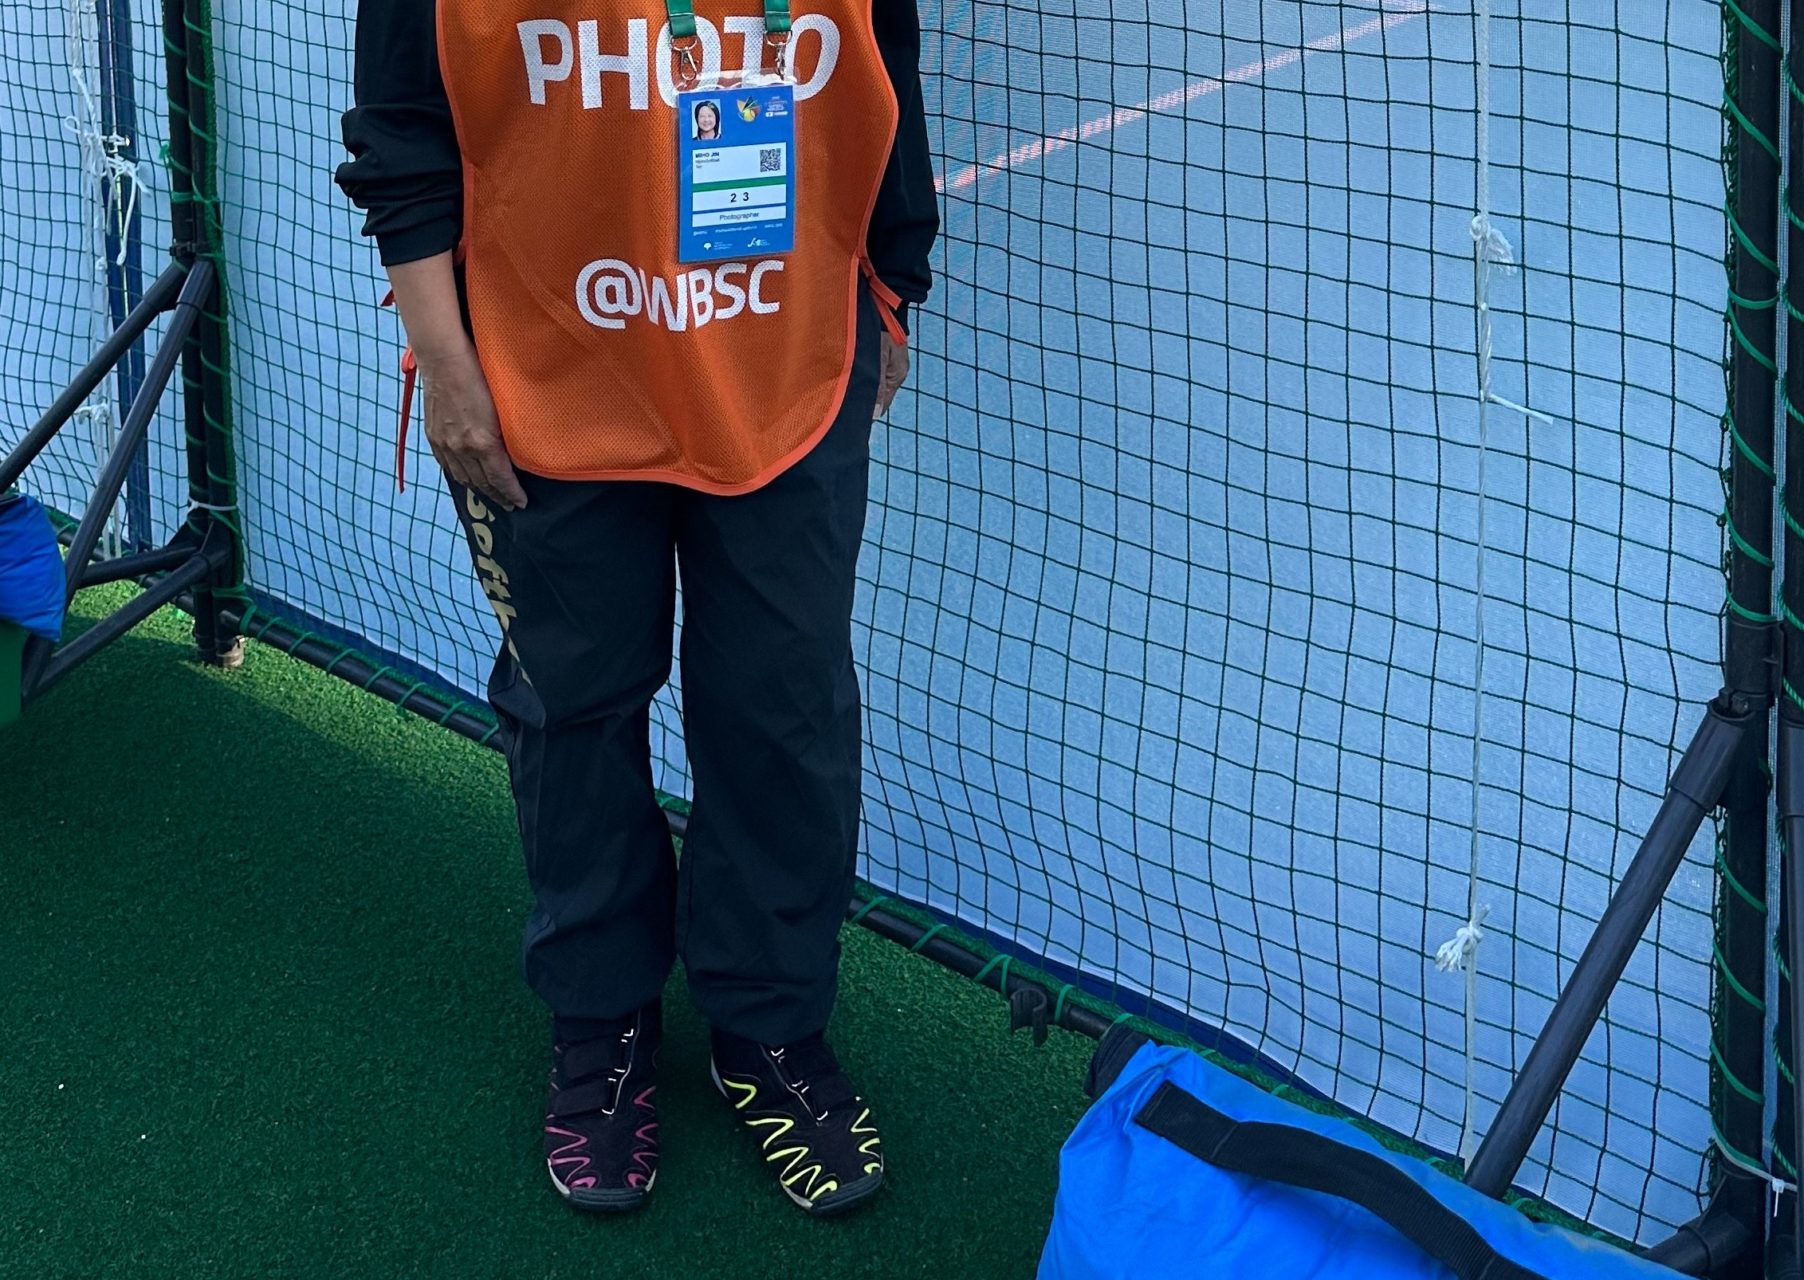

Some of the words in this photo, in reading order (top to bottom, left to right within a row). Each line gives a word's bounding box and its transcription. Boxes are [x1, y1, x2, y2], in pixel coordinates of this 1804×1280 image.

[516, 13, 842, 111] PHOTO
[719, 212, 760, 222] Photographer
[730, 193, 737, 203] 2
[742, 192, 749, 202] 3
[575, 260, 785, 332] @WBSC
